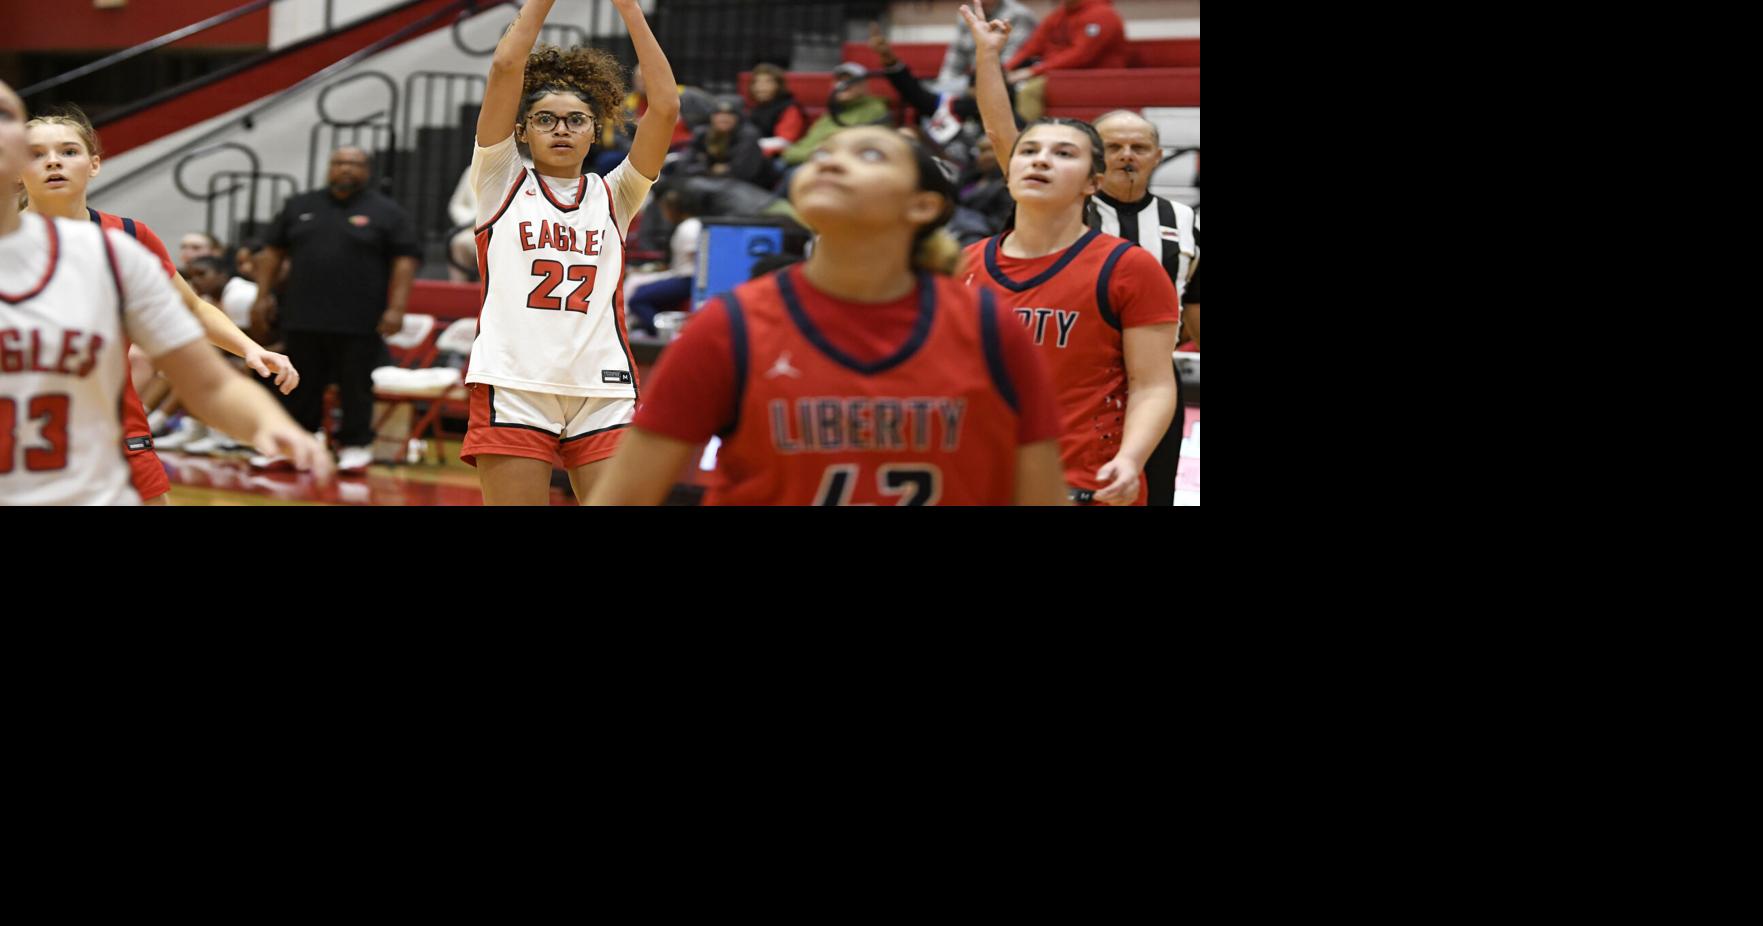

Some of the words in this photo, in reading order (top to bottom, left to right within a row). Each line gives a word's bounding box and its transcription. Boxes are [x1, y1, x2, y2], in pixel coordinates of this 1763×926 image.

[519, 220, 605, 256] EAGLE
[526, 259, 598, 315] 22
[768, 396, 969, 453] LIBERTY
